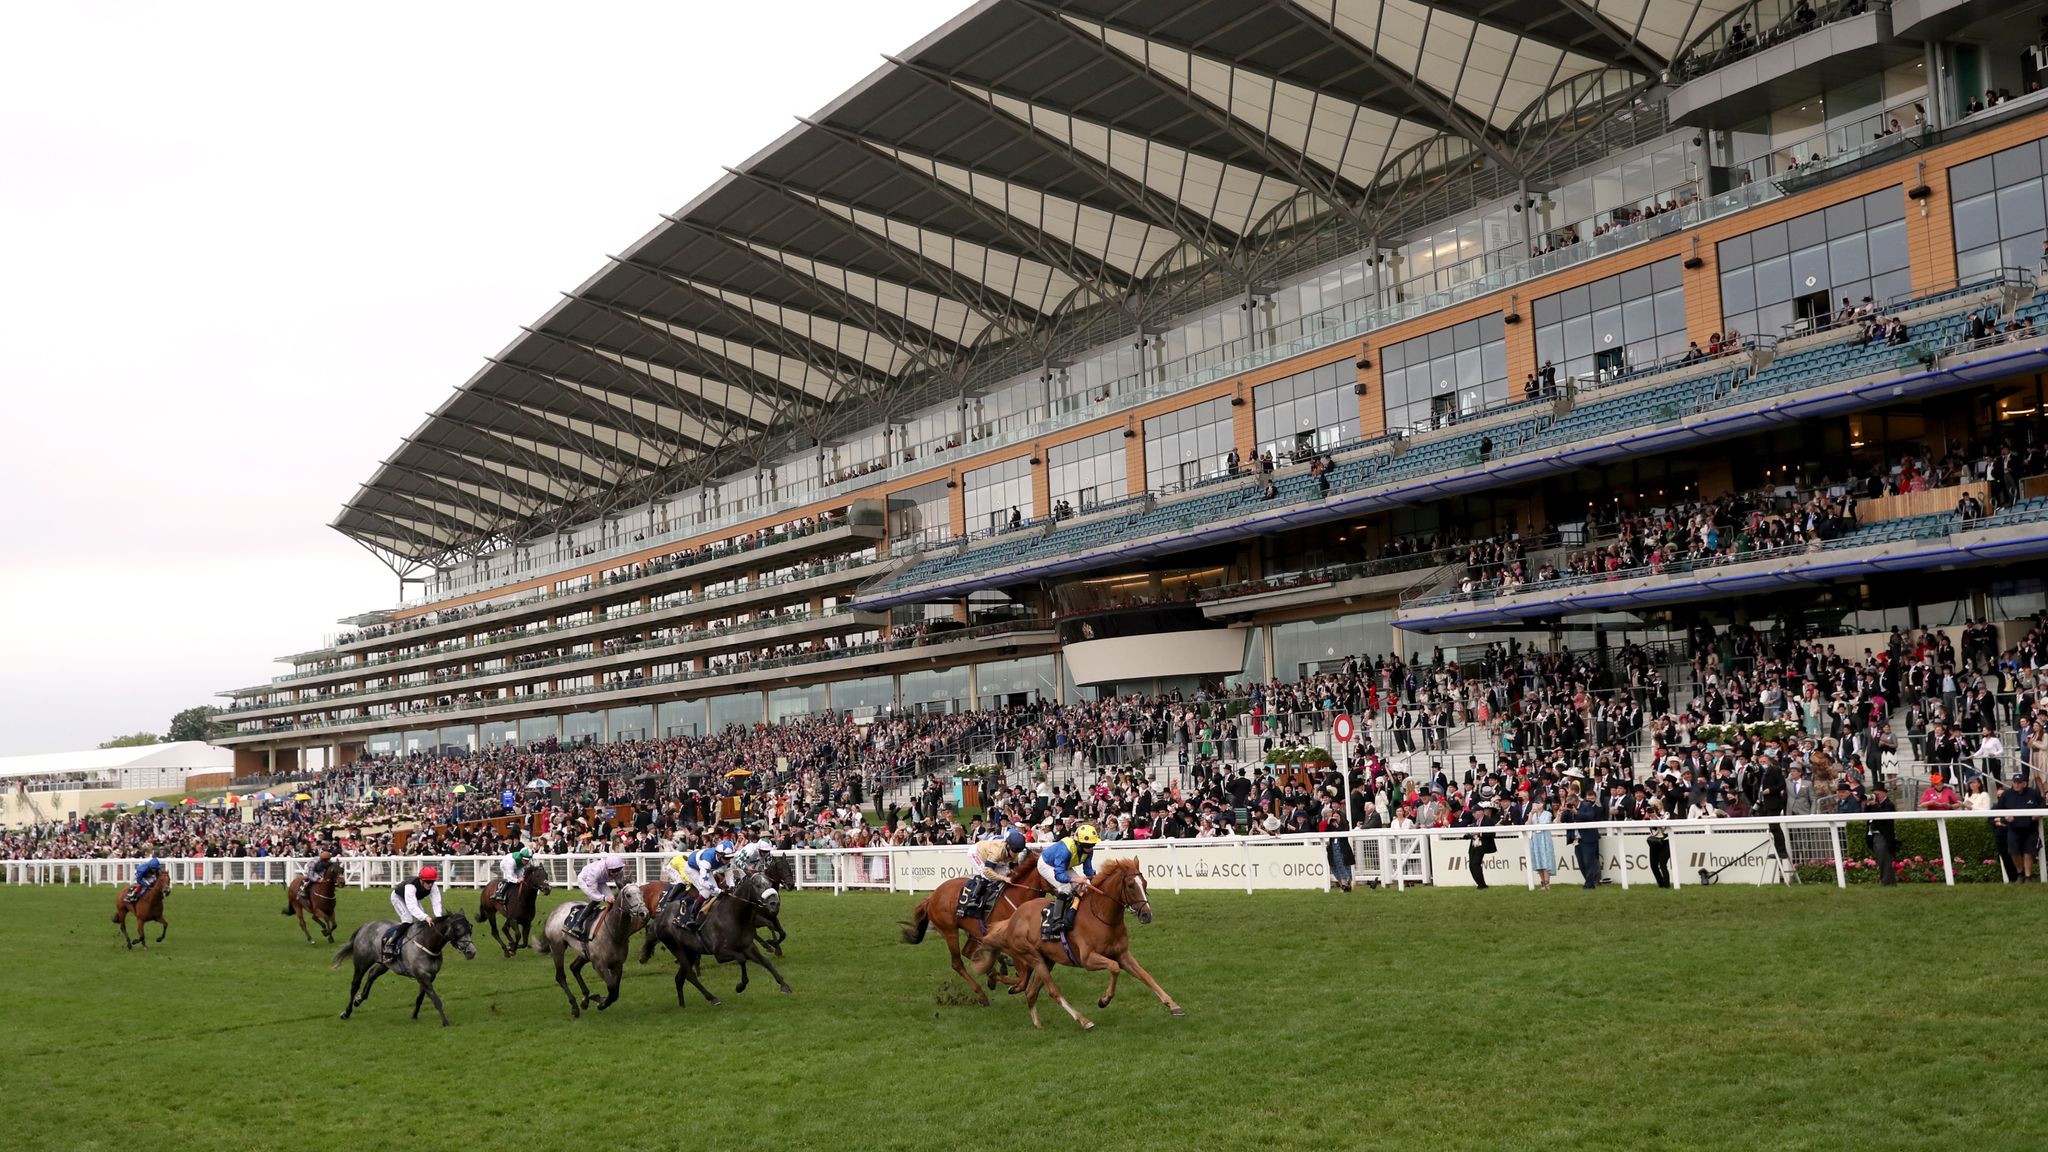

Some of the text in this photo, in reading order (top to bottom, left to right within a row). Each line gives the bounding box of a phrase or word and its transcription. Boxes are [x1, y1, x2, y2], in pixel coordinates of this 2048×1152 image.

[1464, 856, 1509, 869] hwden
[1709, 852, 1764, 867] howden
[1147, 864, 1192, 877] ROYAL
[959, 886, 972, 905] 5
[1042, 907, 1051, 927] 2
